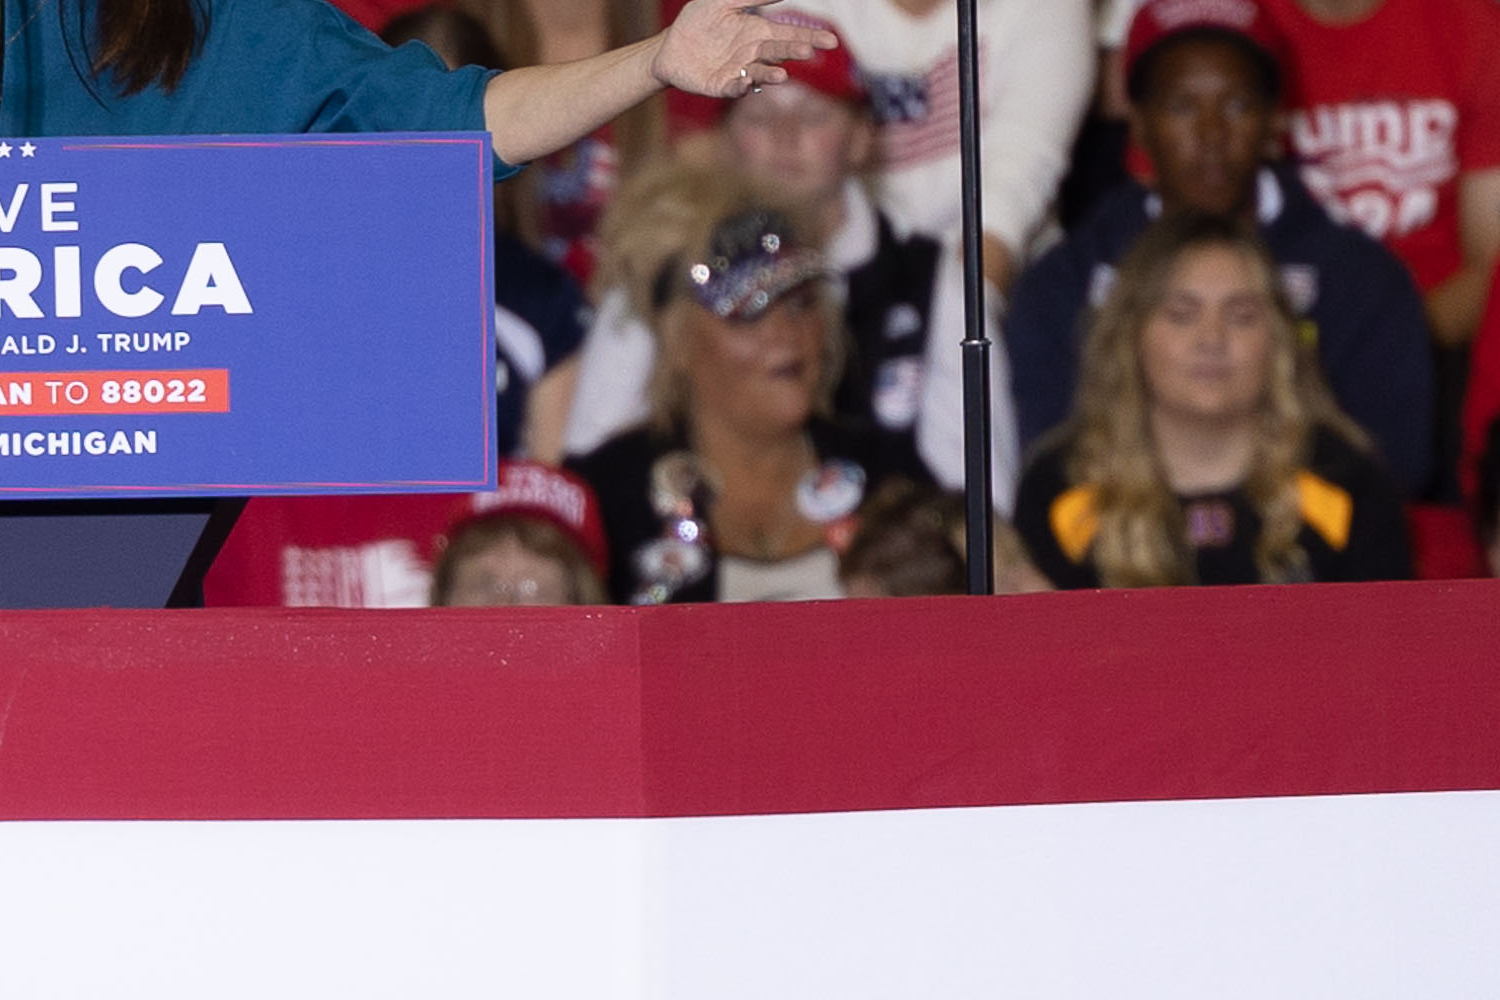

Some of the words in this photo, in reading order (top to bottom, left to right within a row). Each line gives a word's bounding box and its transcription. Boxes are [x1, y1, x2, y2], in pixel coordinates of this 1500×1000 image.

[65, 334, 87, 354] J.
[97, 331, 191, 353] TRUMP
[44, 381, 89, 405] TO
[101, 378, 207, 404] 88022
